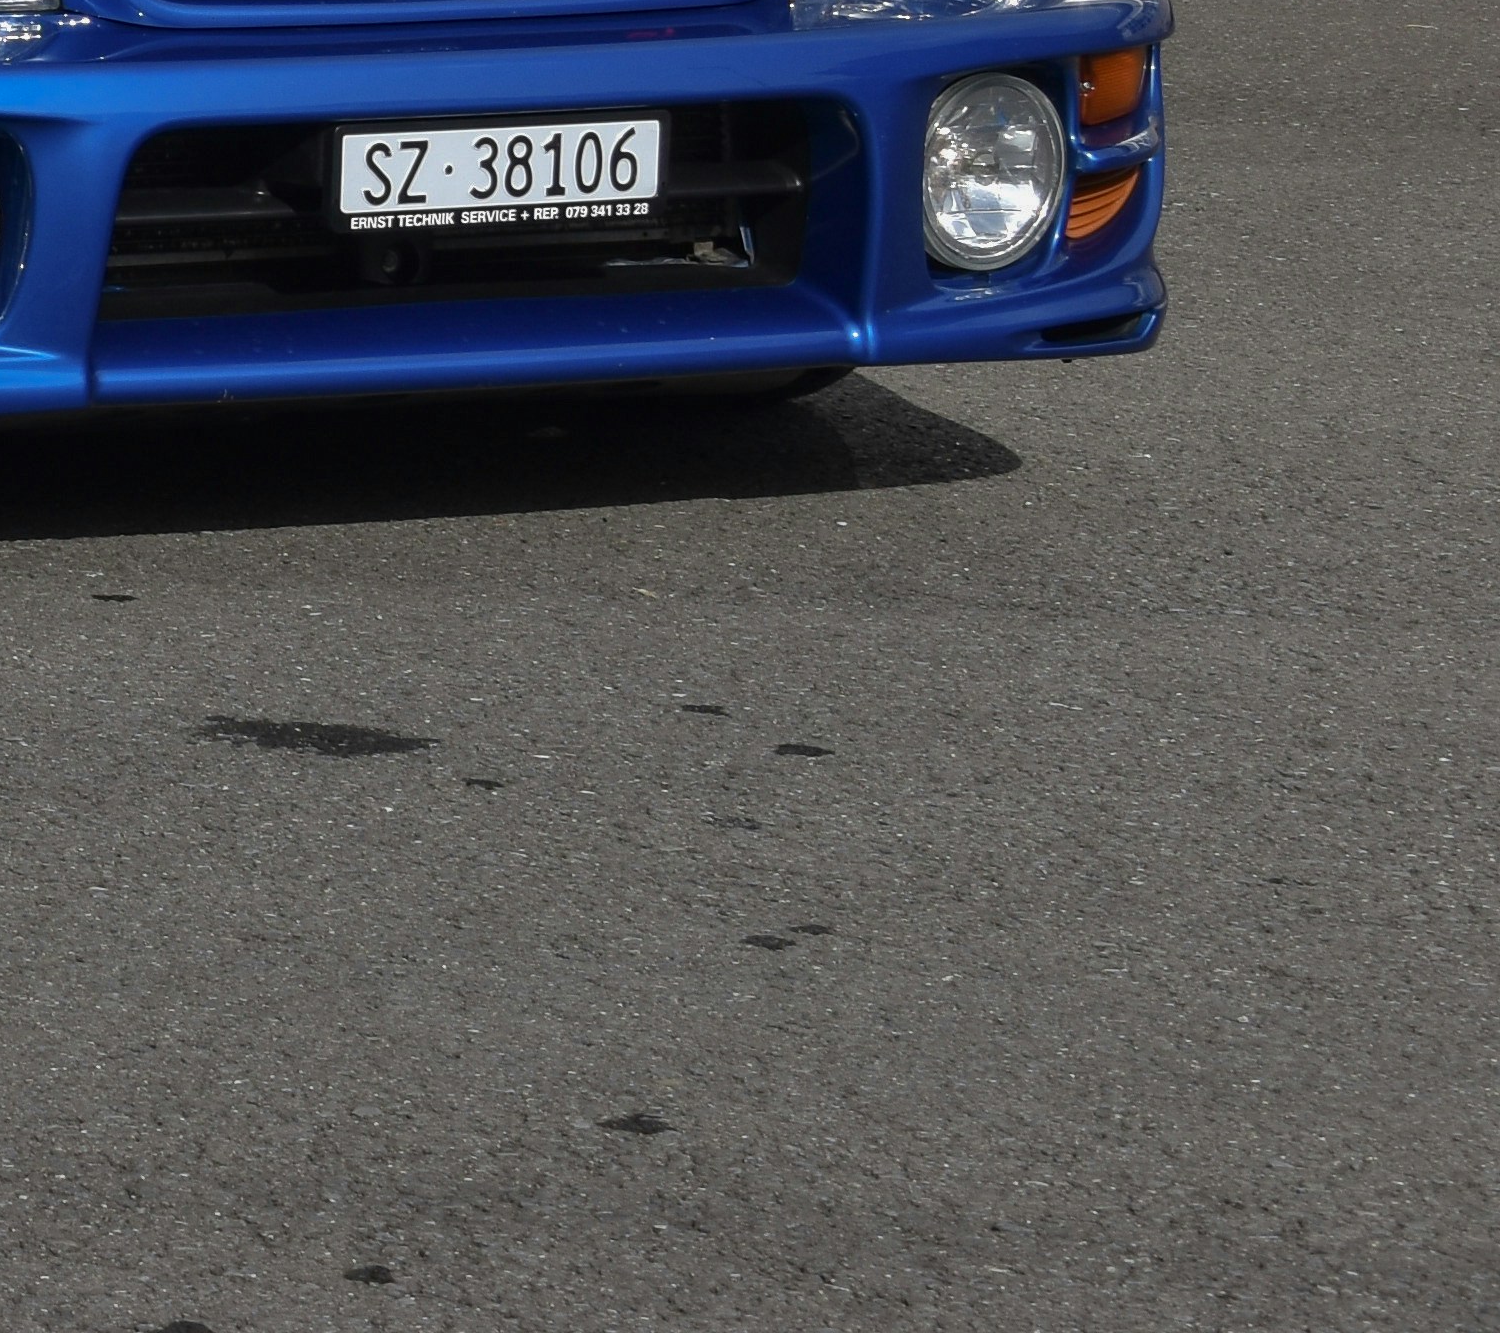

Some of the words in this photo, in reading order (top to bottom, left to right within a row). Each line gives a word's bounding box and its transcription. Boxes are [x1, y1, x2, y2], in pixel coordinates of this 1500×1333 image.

[350, 215, 395, 229] ERNST
[398, 212, 455, 227] TECHNIK
[460, 209, 517, 224] SERVICE
[534, 207, 560, 220] REP.
[565, 205, 588, 218] 079
[591, 204, 613, 217] 341
[615, 204, 631, 216] 33
[633, 202, 649, 215] 28
